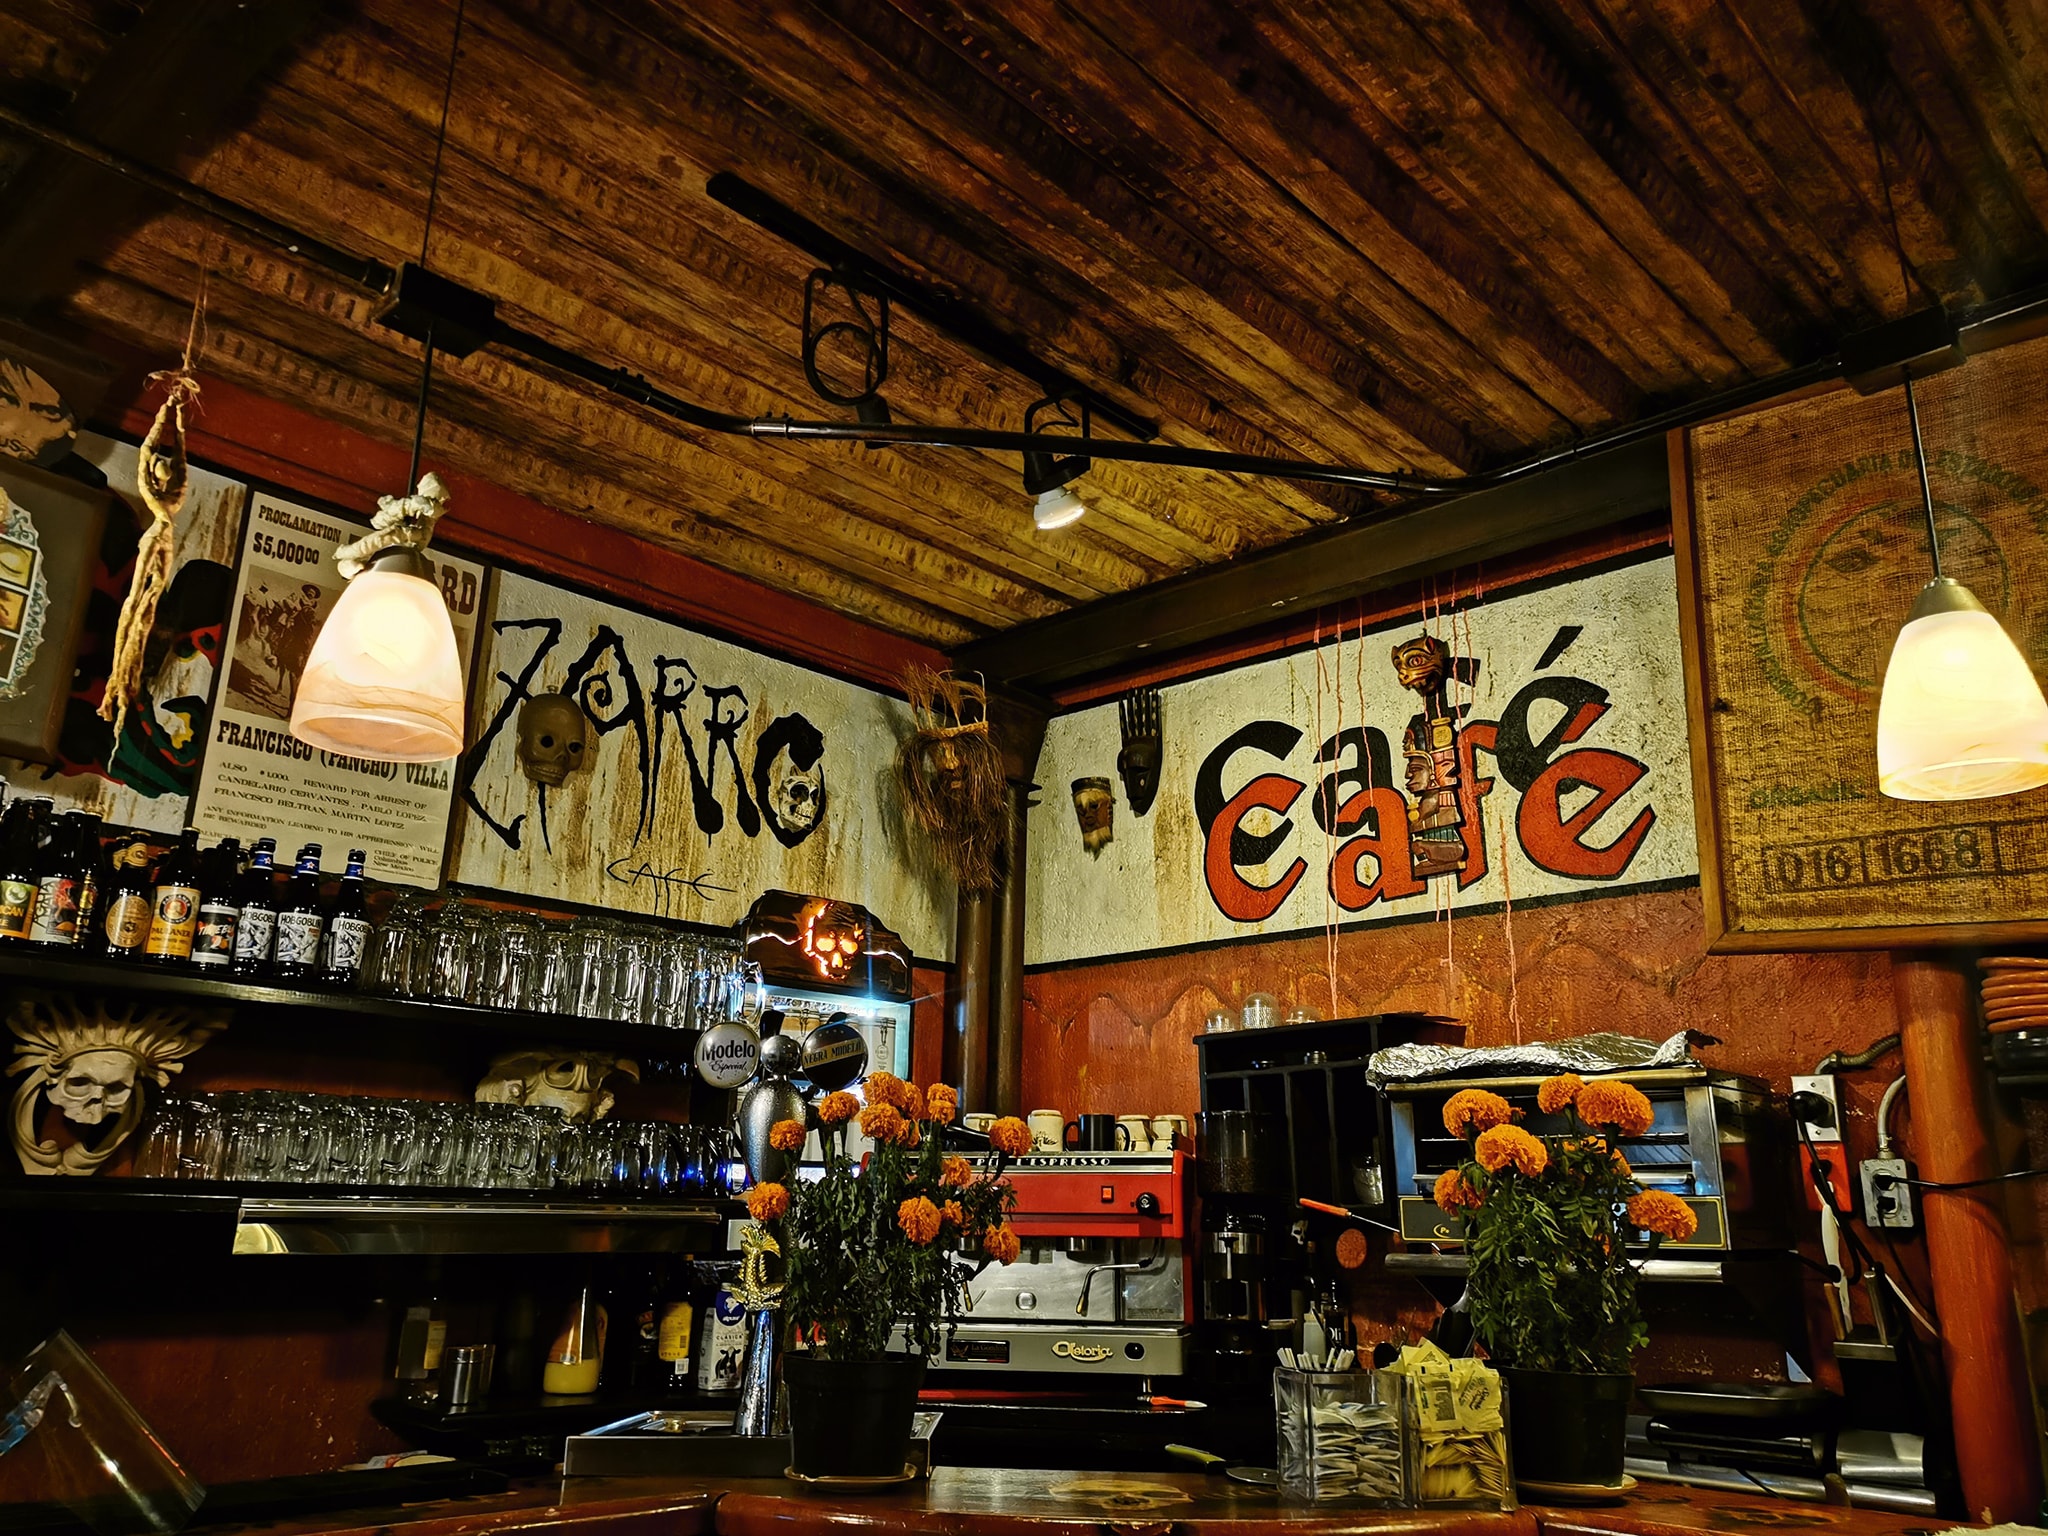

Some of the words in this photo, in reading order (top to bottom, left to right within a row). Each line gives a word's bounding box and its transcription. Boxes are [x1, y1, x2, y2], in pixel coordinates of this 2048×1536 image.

[258, 504, 342, 544] PROCLAMATION
[217, 719, 313, 762] FRANCISCO
[320, 750, 398, 783] (PANCHO)
[405, 762, 449, 791] VILLA
[217, 773, 287, 795] CANDELARIO
[290, 788, 351, 808] CERVANTES
[361, 802, 393, 816] PABLO
[219, 761, 248, 773] ALSO
[303, 778, 347, 794] REWARD
[351, 788, 371, 799] FOR
[374, 794, 412, 808] ARREST
[414, 802, 428, 811] OF
[205, 804, 225, 814] ANY
[226, 808, 285, 826] INFORMATION
[287, 820, 325, 834] LEADING
[327, 826, 338, 836] TO
[214, 786, 274, 805] FRANCISCO
[330, 809, 371, 824] MARTIN
[374, 817, 406, 831] LOPEZ
[218, 814, 268, 830] REWARDED
[702, 1040, 756, 1061] Modelo
[709, 1060, 748, 1073] Especial
[803, 1051, 828, 1065] NEGRA
[831, 1040, 864, 1058] MODELO
[1016, 1157, 1111, 1167] L'ESPRESSO
